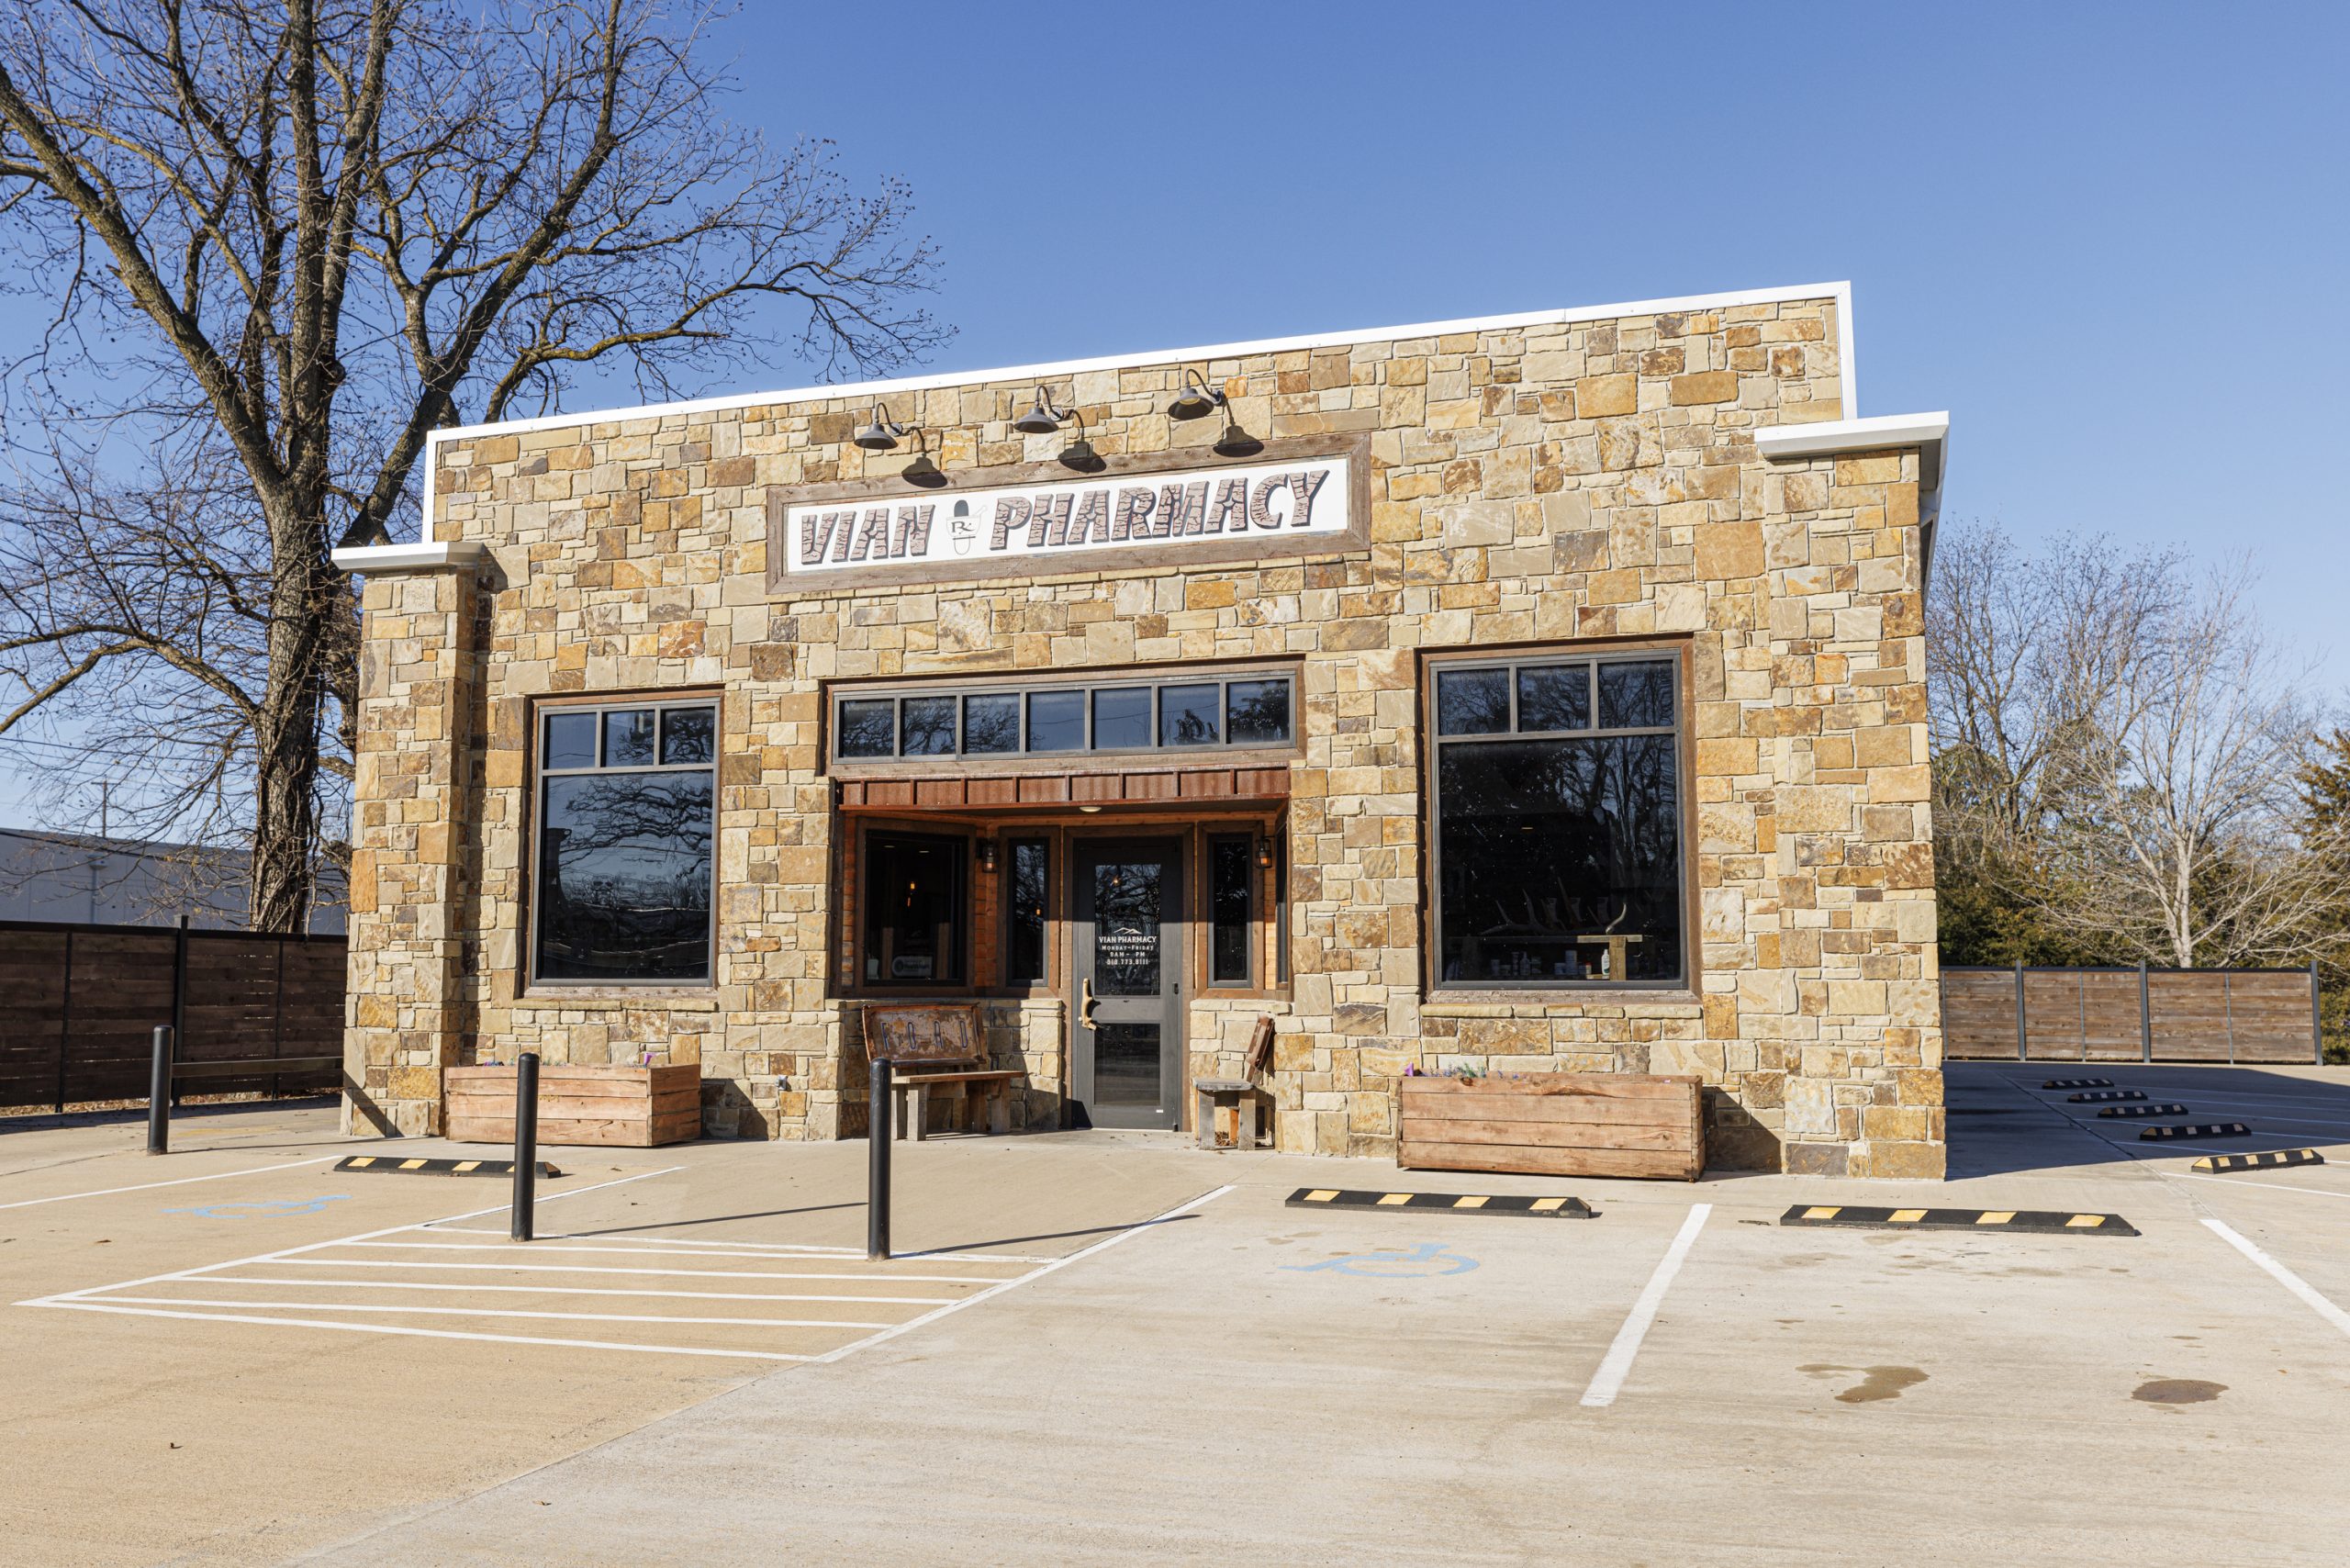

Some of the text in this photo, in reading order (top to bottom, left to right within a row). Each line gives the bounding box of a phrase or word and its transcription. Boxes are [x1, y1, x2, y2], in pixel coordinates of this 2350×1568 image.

[800, 469, 1330, 566] VIAN PHARMACY
[1099, 935, 1157, 944] VIAN PHARMACY
